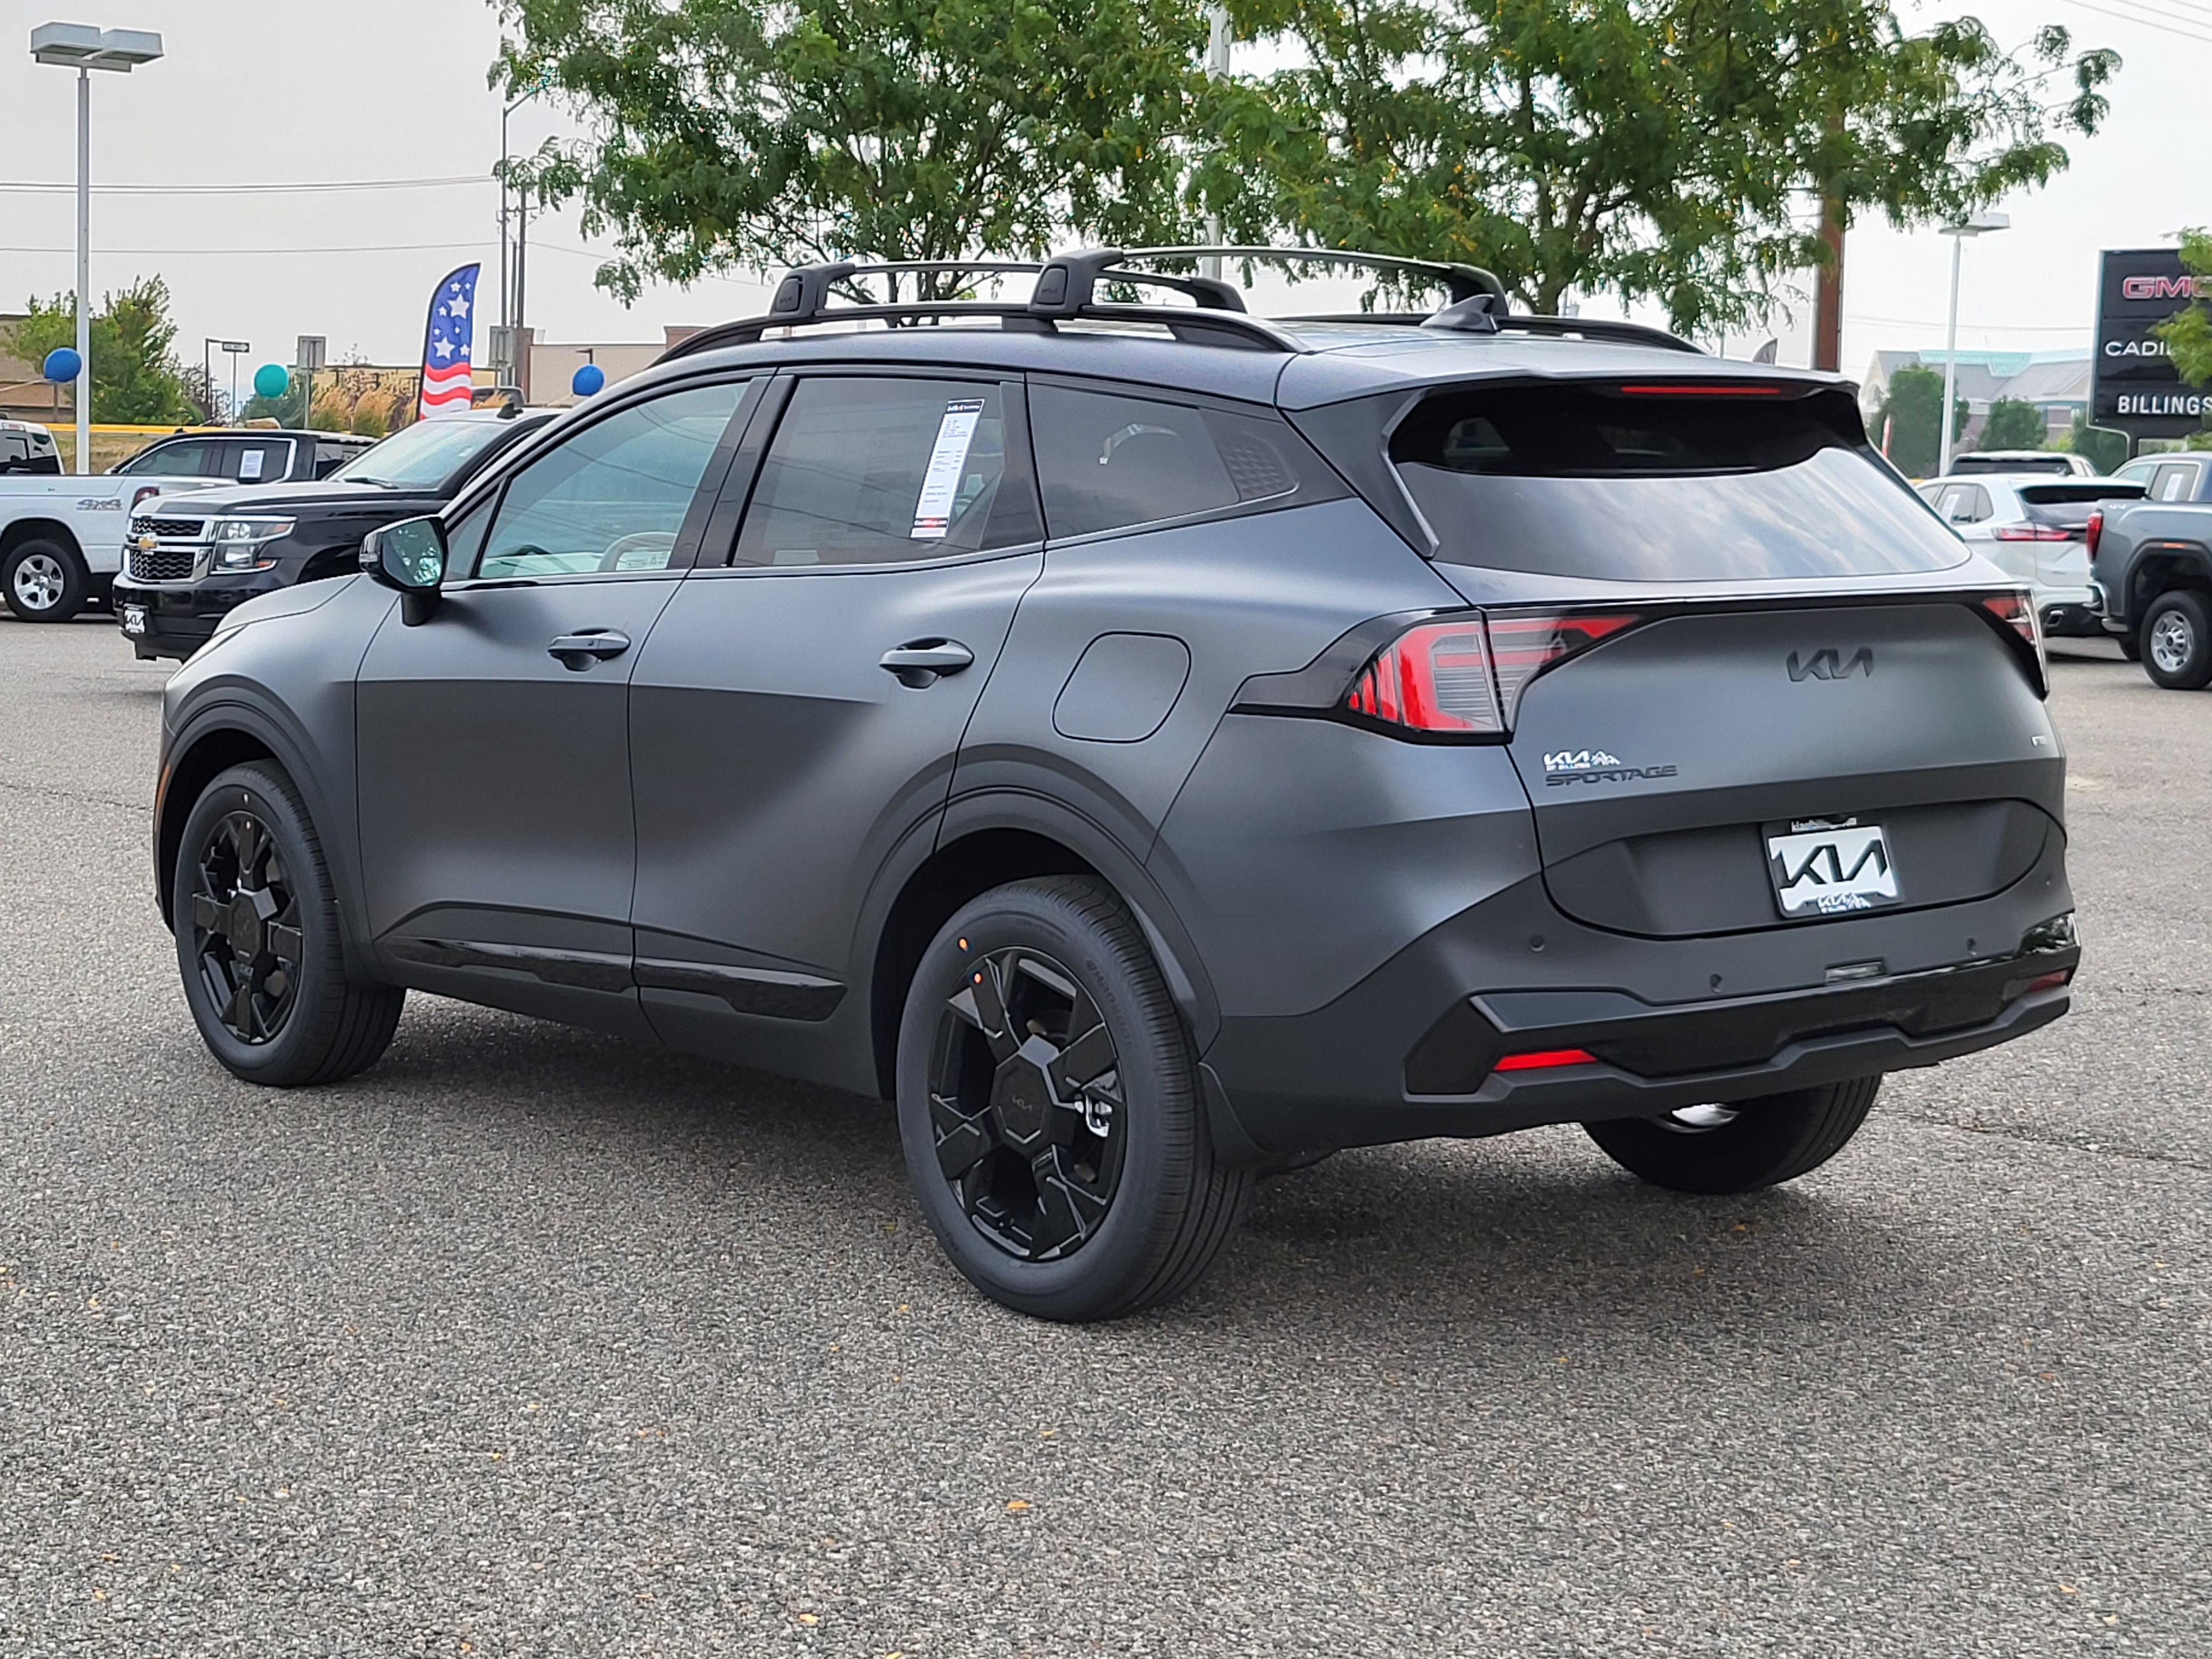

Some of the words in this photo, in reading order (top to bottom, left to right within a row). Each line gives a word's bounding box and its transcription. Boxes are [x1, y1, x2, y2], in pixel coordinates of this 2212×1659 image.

[2117, 395, 2212, 415] BILLINGS
[1786, 647, 1874, 682] KIA
[1543, 750, 1589, 765] KIA
[1546, 765, 1678, 786] SPORTAGE
[1771, 838, 1888, 888] KIA
[1817, 894, 1847, 907] KIA
